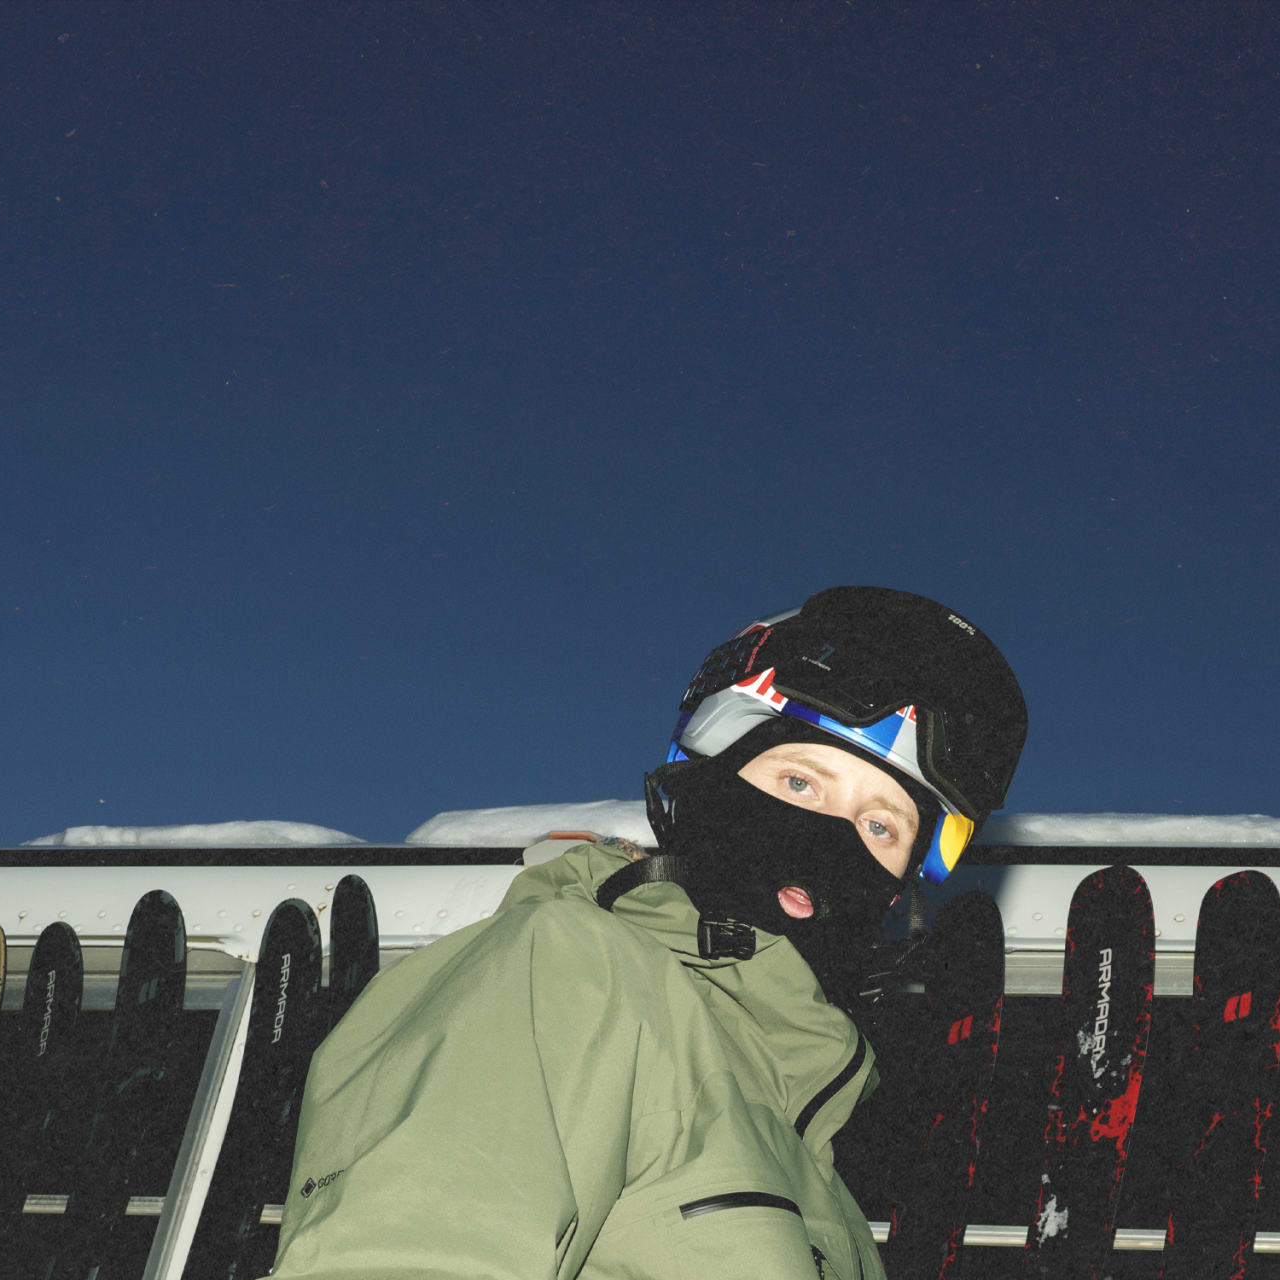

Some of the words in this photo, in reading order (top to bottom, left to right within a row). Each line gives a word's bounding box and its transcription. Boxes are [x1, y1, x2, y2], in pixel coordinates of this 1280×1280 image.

[36, 970, 56, 1057] ARMADA
[271, 953, 291, 1044] ARMADA
[1092, 948, 1112, 1054] ARMADA
